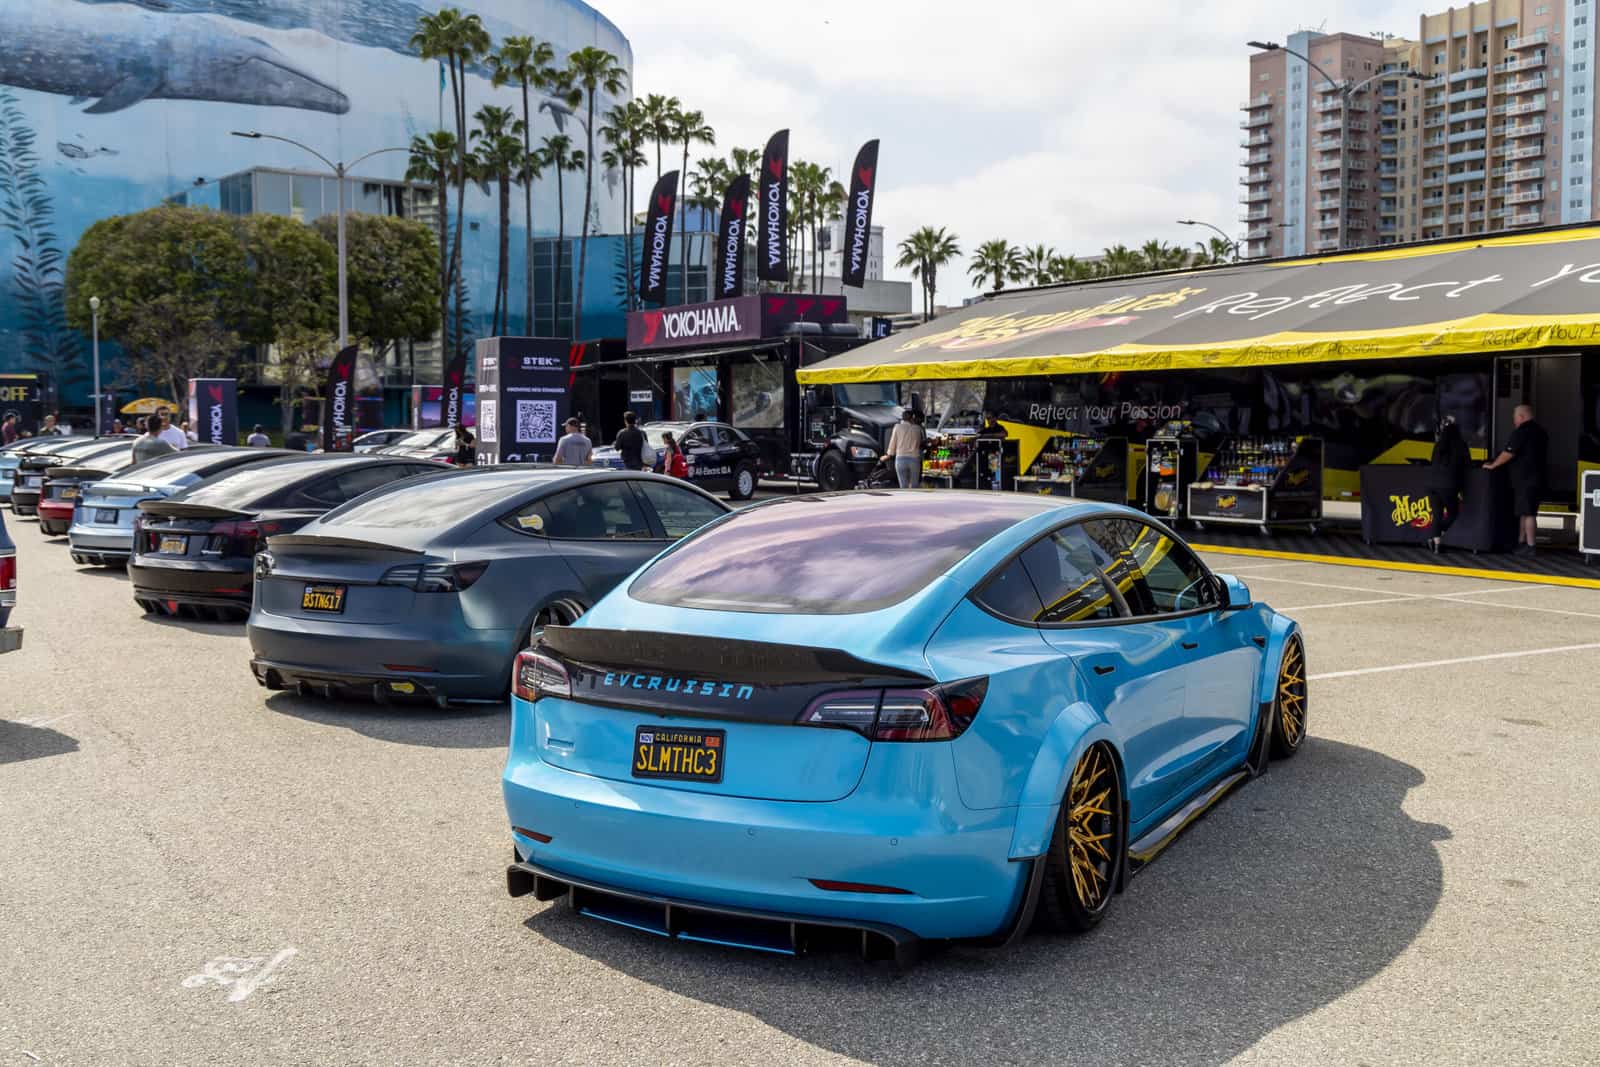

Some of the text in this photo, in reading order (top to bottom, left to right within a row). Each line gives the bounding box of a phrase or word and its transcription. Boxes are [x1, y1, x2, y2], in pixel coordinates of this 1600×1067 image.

[767, 182, 781, 268] YOKOHAMA
[850, 189, 870, 273] YOKOHAMA
[648, 215, 668, 290] YOKOHAMA
[724, 219, 741, 292] YOKOHAMA
[1174, 274, 1503, 320] Reflect
[663, 305, 740, 338] YOKOHAMA
[210, 404, 222, 445] YOKOH
[333, 381, 347, 428] YOKOHA
[448, 386, 458, 430] YOKOHA
[1029, 402, 1181, 424] Reflect Your Passion
[304, 593, 341, 608] BSTN617
[637, 744, 717, 775] SLMTHC3
[655, 732, 702, 743] CALIFORNIA
